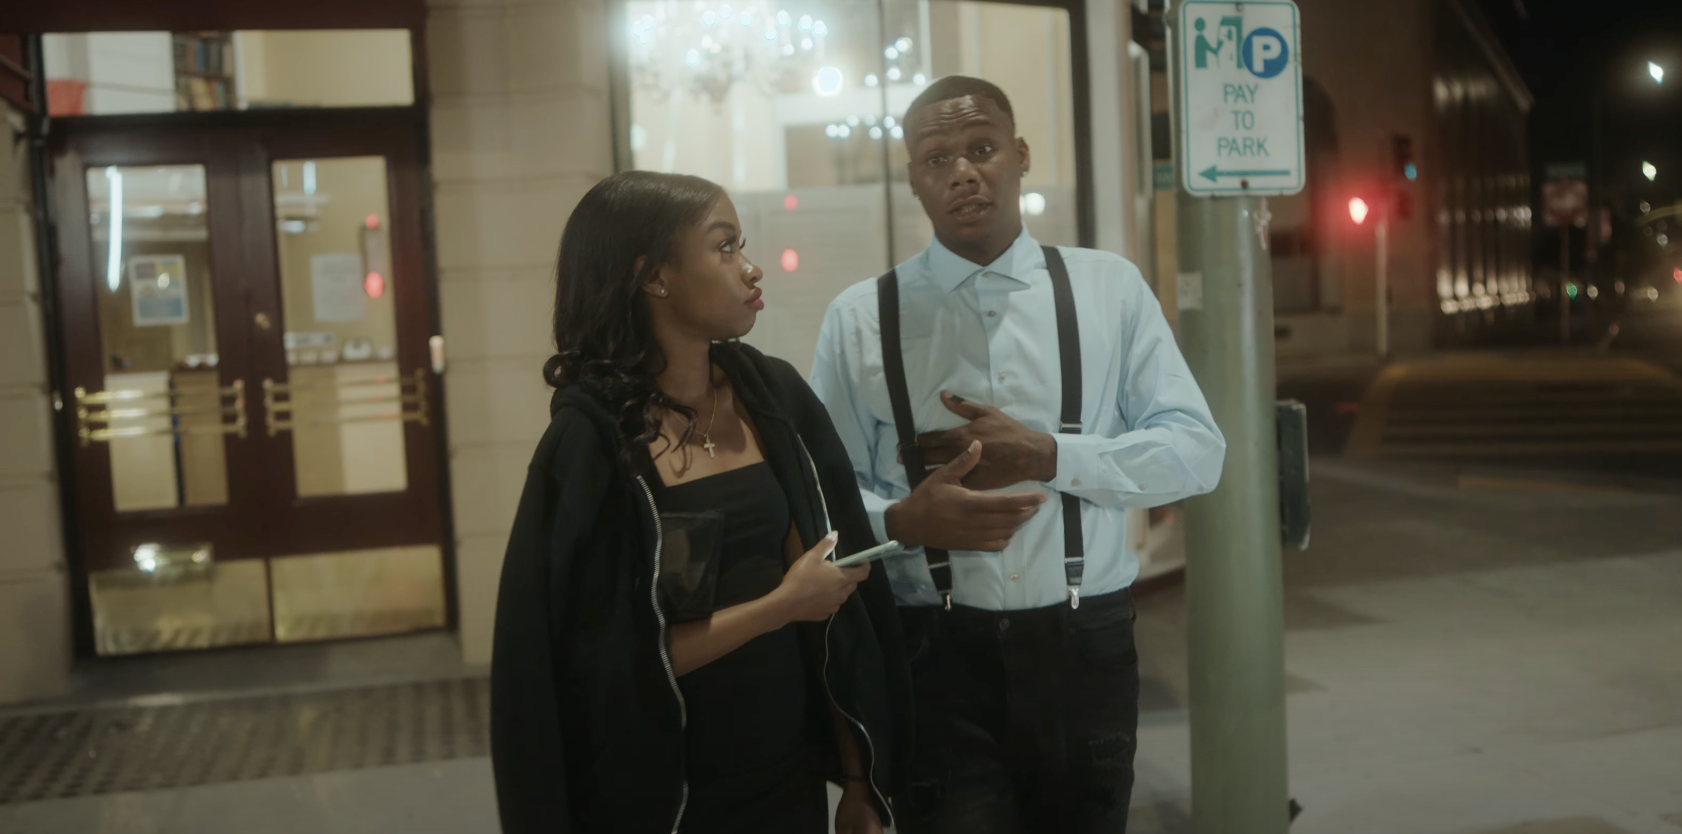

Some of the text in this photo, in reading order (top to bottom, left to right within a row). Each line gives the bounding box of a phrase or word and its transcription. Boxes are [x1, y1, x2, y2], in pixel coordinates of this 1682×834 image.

[1252, 35, 1282, 73] P
[1223, 83, 1259, 104] PAY
[1232, 110, 1255, 130] TO
[1217, 136, 1269, 157] PARK
